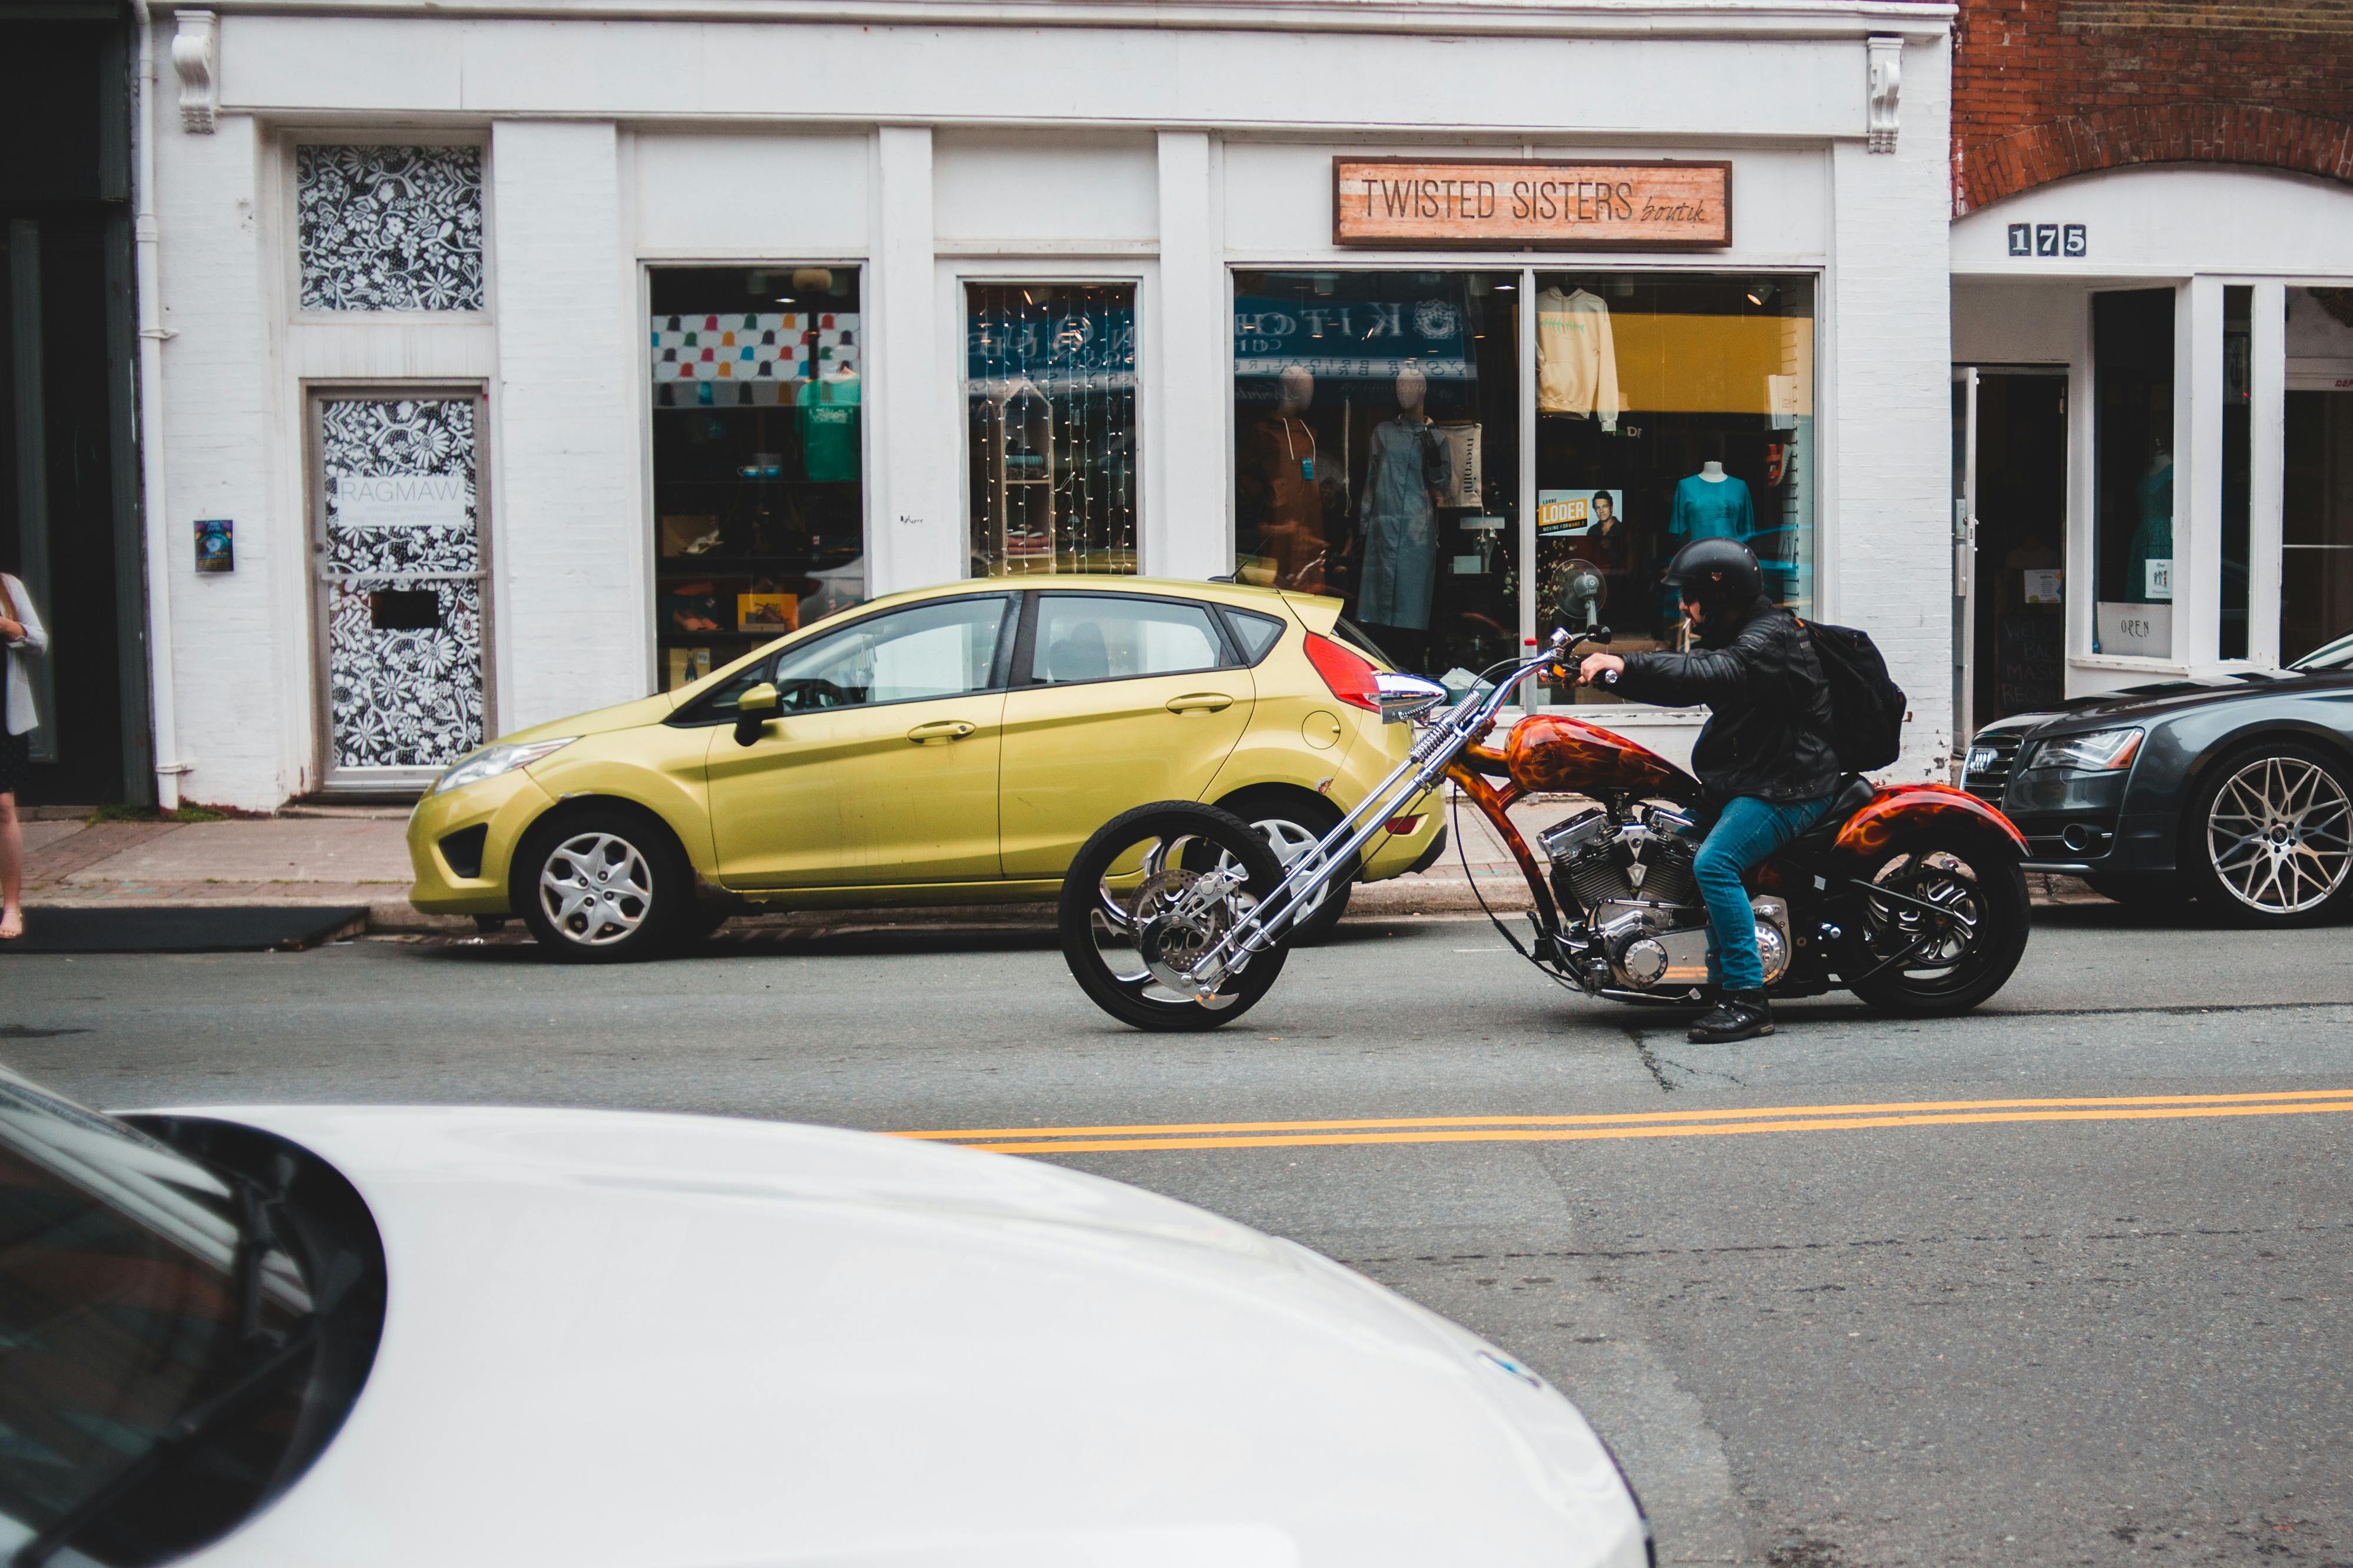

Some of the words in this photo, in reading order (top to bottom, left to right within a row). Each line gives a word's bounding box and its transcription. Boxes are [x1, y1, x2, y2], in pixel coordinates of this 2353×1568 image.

[1361, 180, 1495, 218] TWISTED
[1512, 181, 1633, 221] SISTERS
[1640, 196, 1705, 221] boutik
[2012, 229, 2085, 251] 175
[1464, 437, 1477, 493] mernini
[341, 480, 459, 502] RAGMAW
[1543, 502, 1584, 523] LODER
[2121, 619, 2149, 637] OPEN
